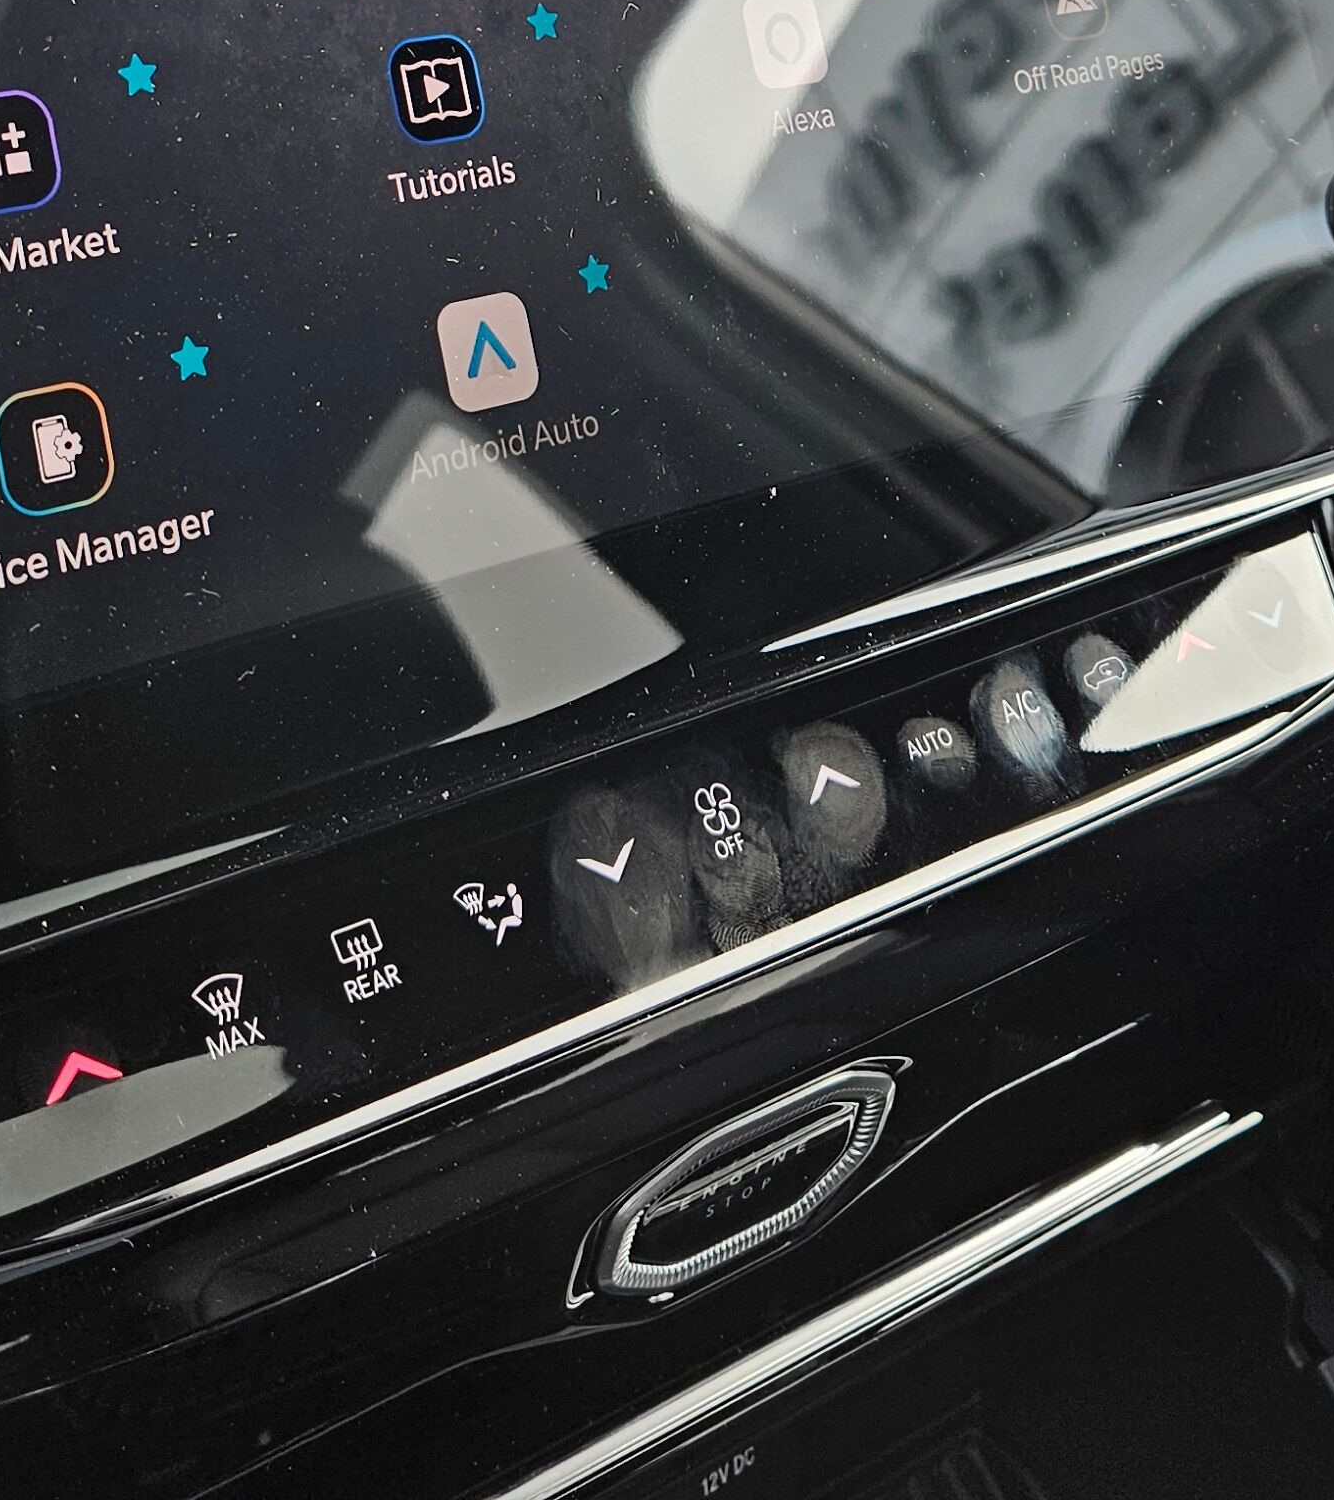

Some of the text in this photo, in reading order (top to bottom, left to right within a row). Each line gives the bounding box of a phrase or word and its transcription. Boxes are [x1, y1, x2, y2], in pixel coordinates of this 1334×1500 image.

[1014, 49, 1164, 95] Off Road Pages
[772, 104, 835, 136] Alexa
[388, 156, 516, 205] Tutorials
[409, 414, 600, 484] Android Auto
[57, 507, 216, 575] Manager
[1001, 688, 1042, 723] A/C
[907, 726, 953, 760] AUTO
[714, 831, 745, 860] OFF
[342, 963, 403, 1003] REAR
[205, 1016, 266, 1060] MAX
[706, 1176, 772, 1218] STOP
[701, 1446, 756, 1497] 12V DC
